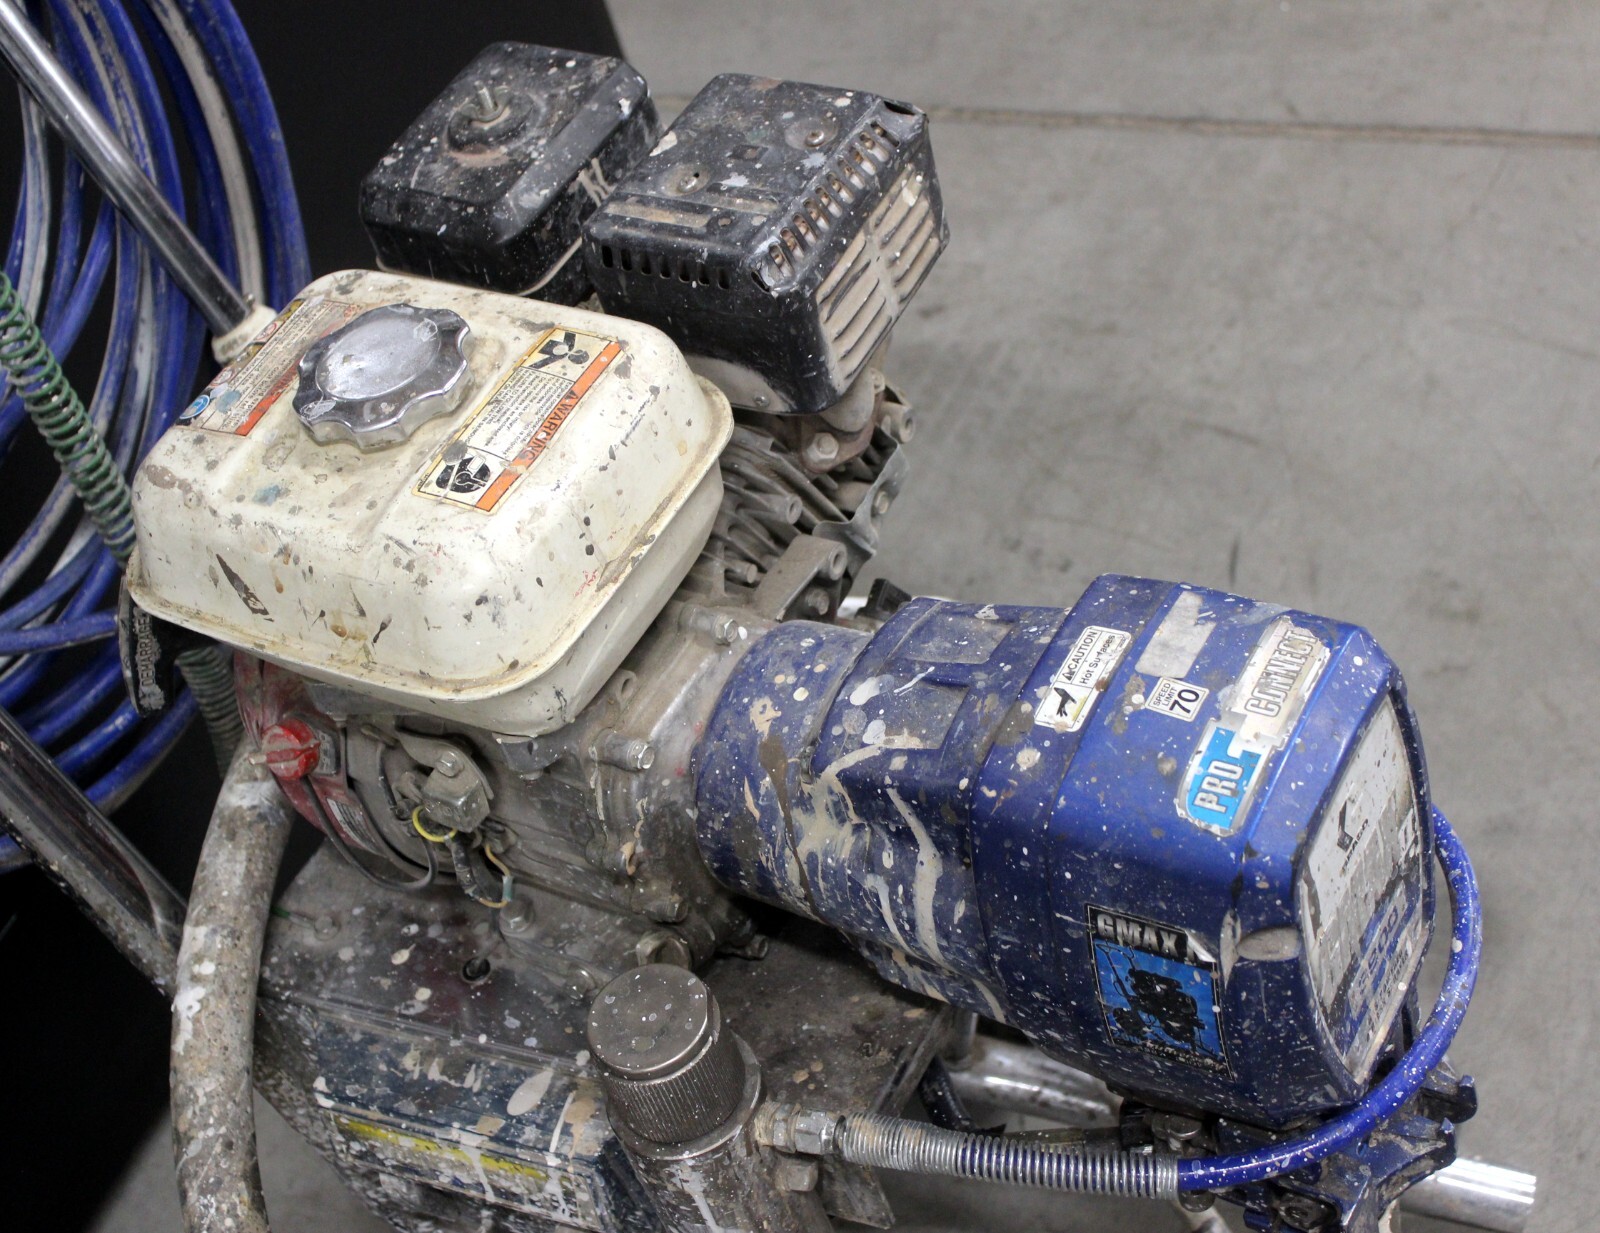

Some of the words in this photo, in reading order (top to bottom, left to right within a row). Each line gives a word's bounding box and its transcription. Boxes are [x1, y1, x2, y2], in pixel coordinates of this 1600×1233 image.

[1067, 631, 1098, 673] CAUTION
[1079, 669, 1094, 684] Hot
[1153, 682, 1171, 706] SPEED
[1162, 687, 1178, 707] LIMIT
[1169, 688, 1200, 714] 70
[1193, 759, 1244, 814] PRO
[1243, 629, 1320, 718] CONNECT
[1097, 912, 1179, 958] GMAX
